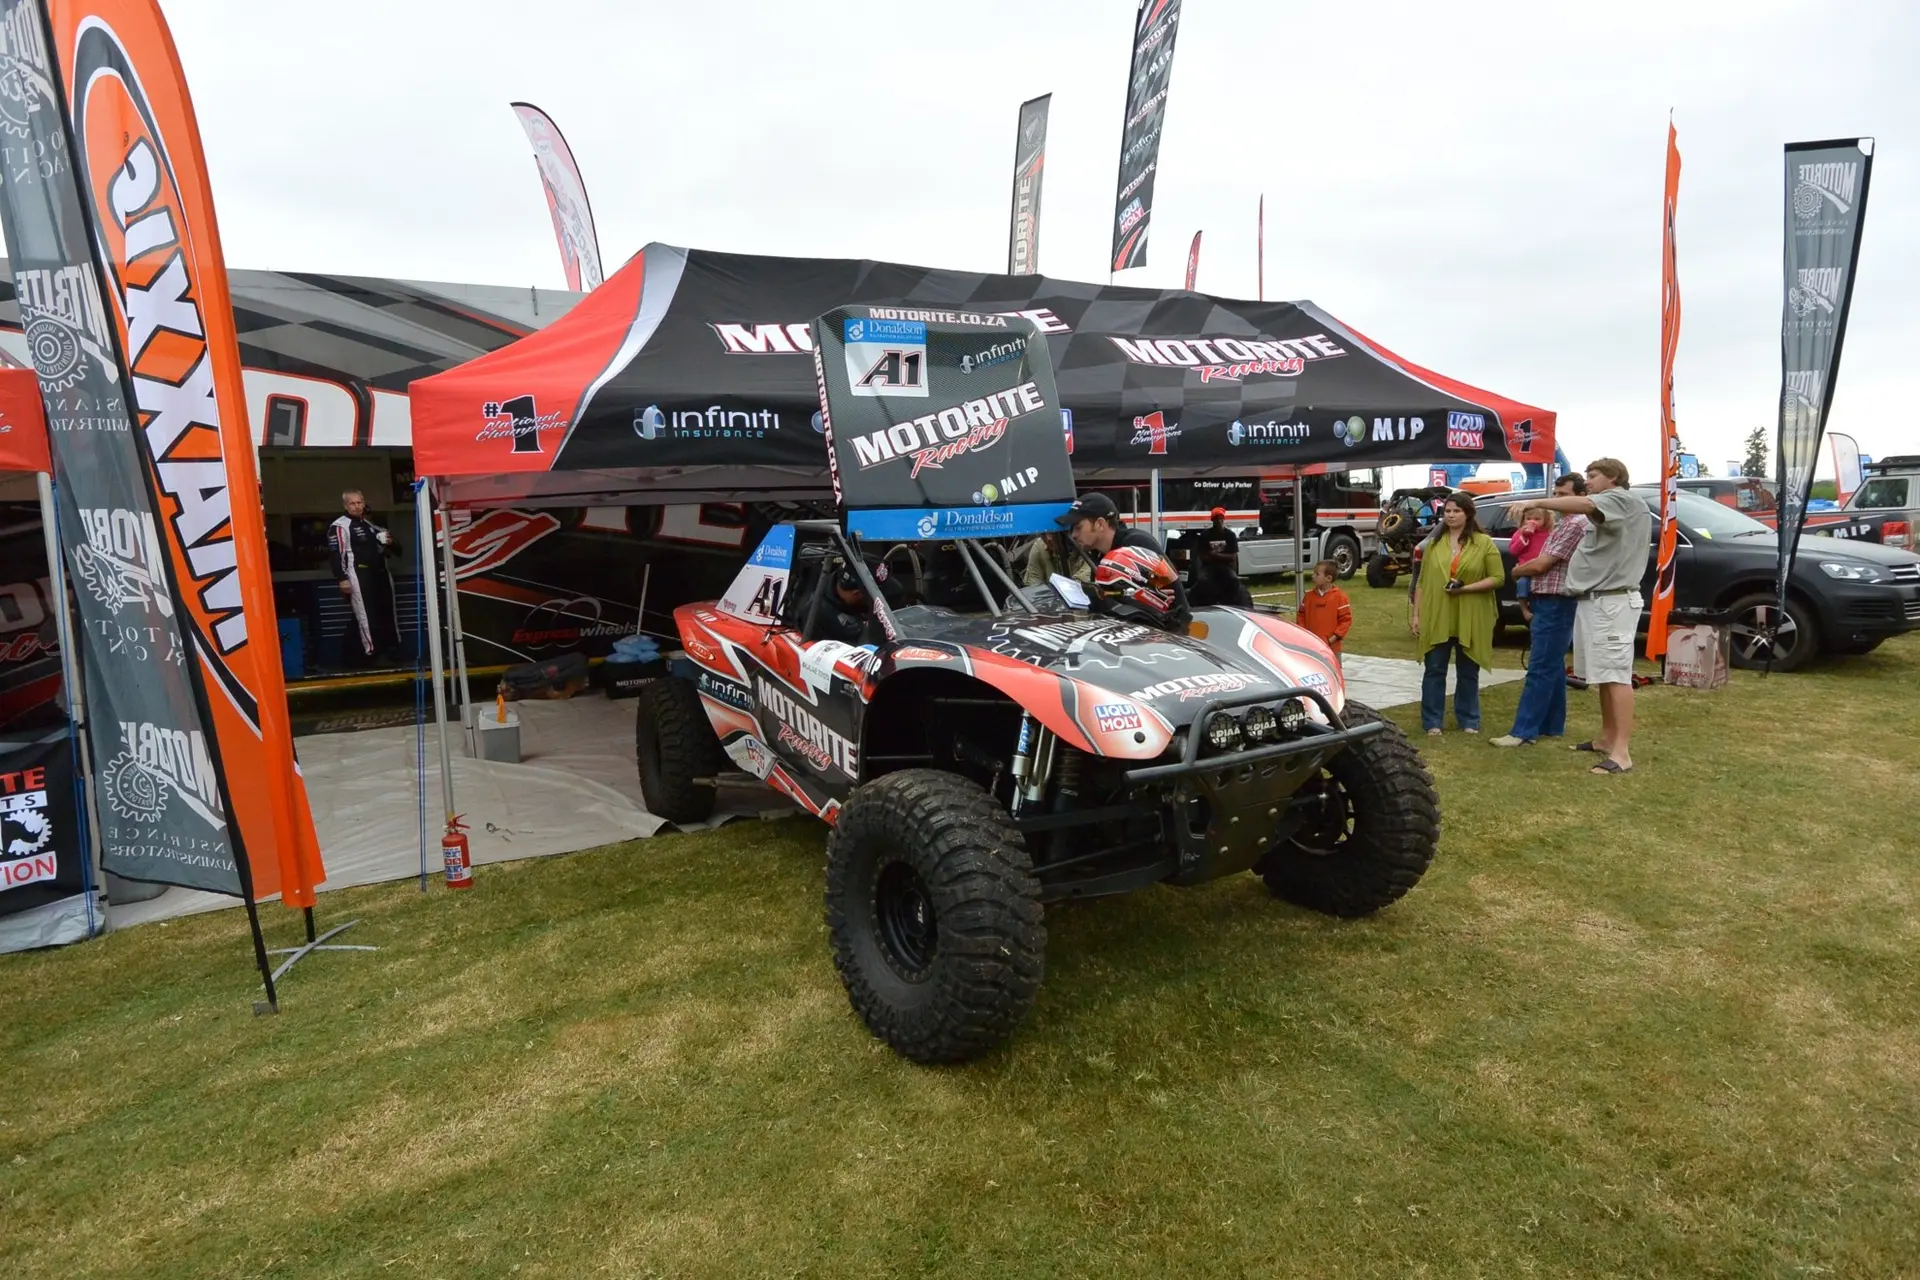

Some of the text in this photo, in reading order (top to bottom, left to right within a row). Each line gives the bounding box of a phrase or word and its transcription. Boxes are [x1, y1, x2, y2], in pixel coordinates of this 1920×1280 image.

[869, 308, 1008, 328] MOTORITE.CO.ZA
[869, 321, 923, 334] Donaldson
[975, 338, 1026, 364] infiniti
[1109, 333, 1348, 367] MOTORITE
[856, 350, 922, 388] A1
[1189, 355, 1305, 384] Racing
[486, 410, 560, 432] National
[672, 406, 780, 430] infiniti
[850, 382, 1045, 469] MOTORITE
[1248, 420, 1310, 437] infiniti
[1372, 417, 1425, 441] MIP
[1449, 413, 1484, 431] LIQUI
[475, 419, 569, 442] Champions
[674, 429, 765, 439] insurance
[1449, 431, 1481, 447] MOLY
[910, 417, 1010, 479] Racing
[1001, 467, 1039, 495] MIP
[946, 510, 1013, 525] Donaldson
[1833, 524, 1871, 538] MIP
[744, 574, 784, 619] A1
[1128, 673, 1272, 702] MOTORITE
[1095, 705, 1135, 718] LIQUI
[757, 675, 859, 779] MOTORITE
[1100, 715, 1138, 732] MOLY
